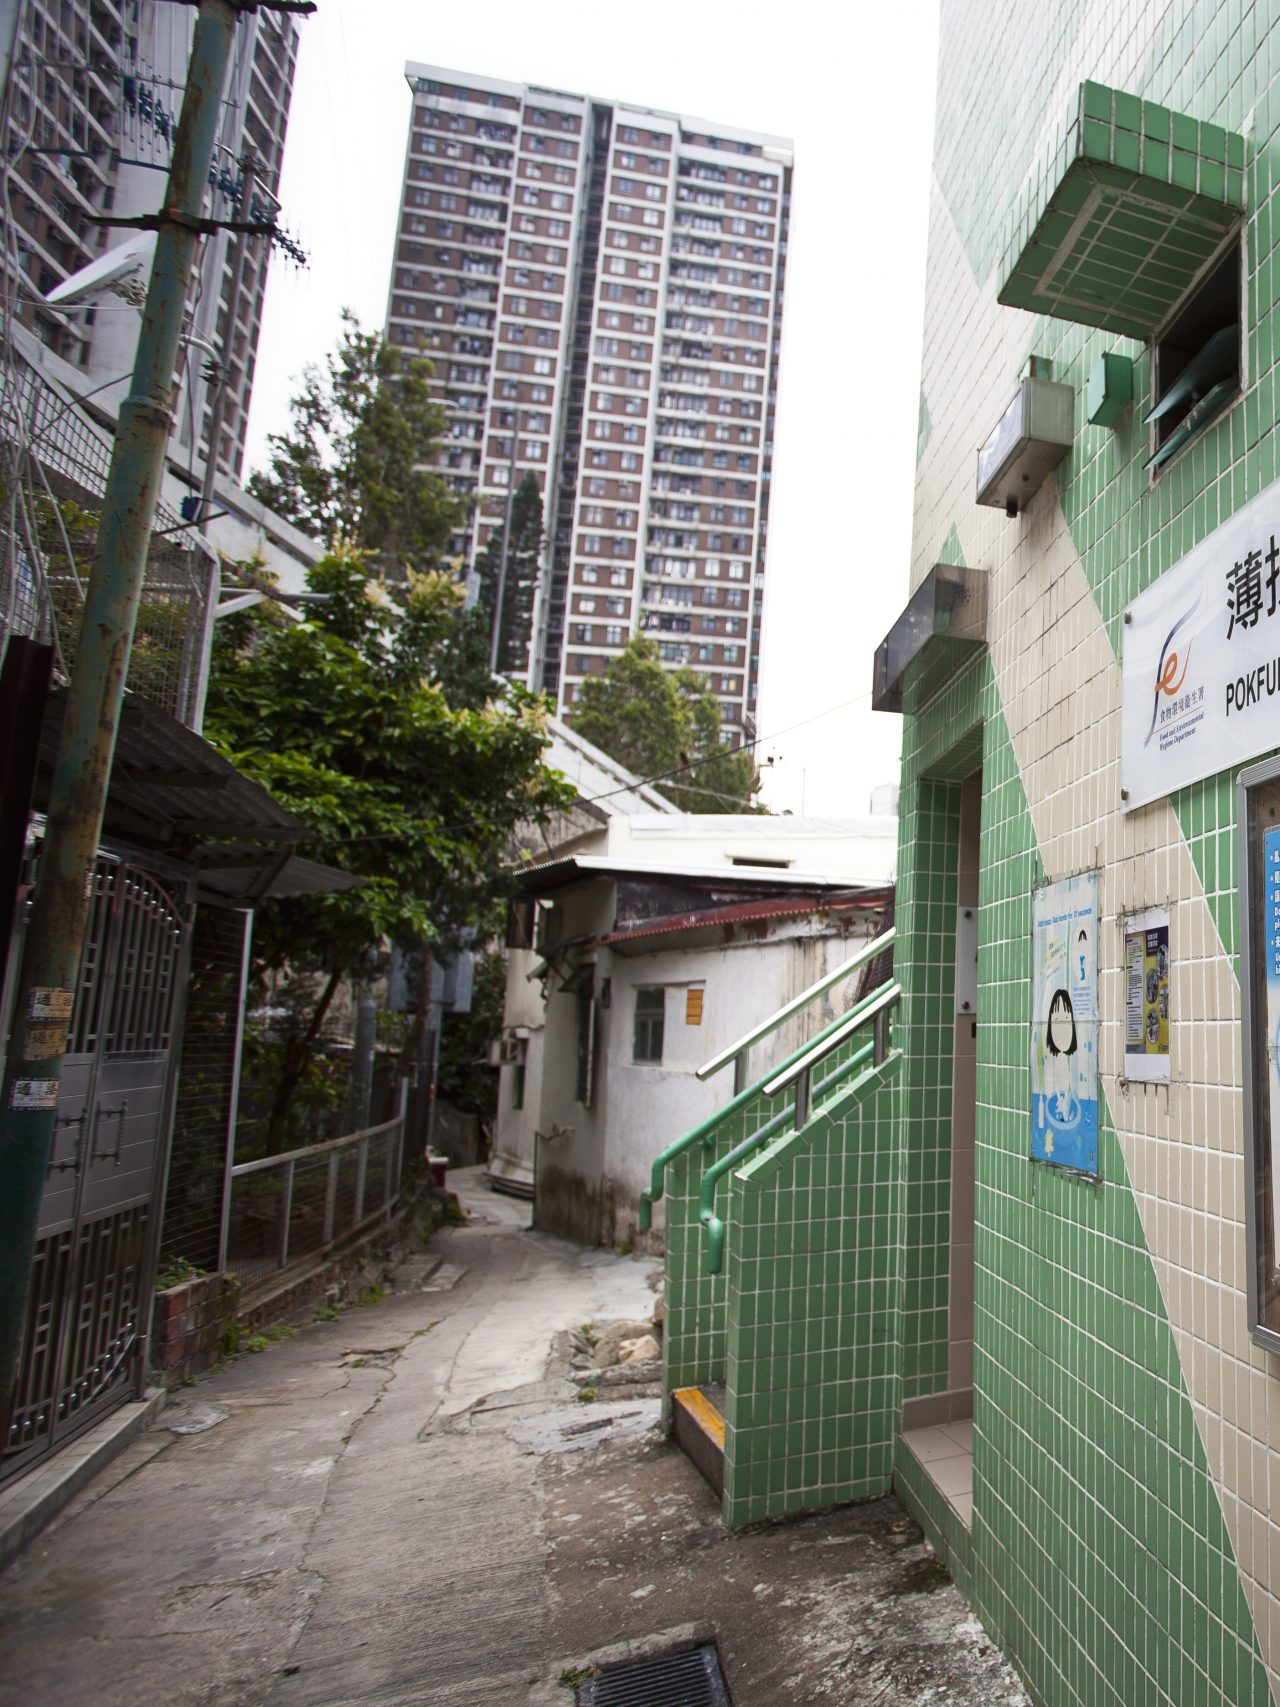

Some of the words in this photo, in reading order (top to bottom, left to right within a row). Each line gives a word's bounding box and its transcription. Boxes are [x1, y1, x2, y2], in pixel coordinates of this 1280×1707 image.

[1160, 731, 1168, 741] Food
[1177, 711, 1204, 732] Environmental
[1160, 740, 1173, 751] Hygiene
[1174, 727, 1195, 743] Department
